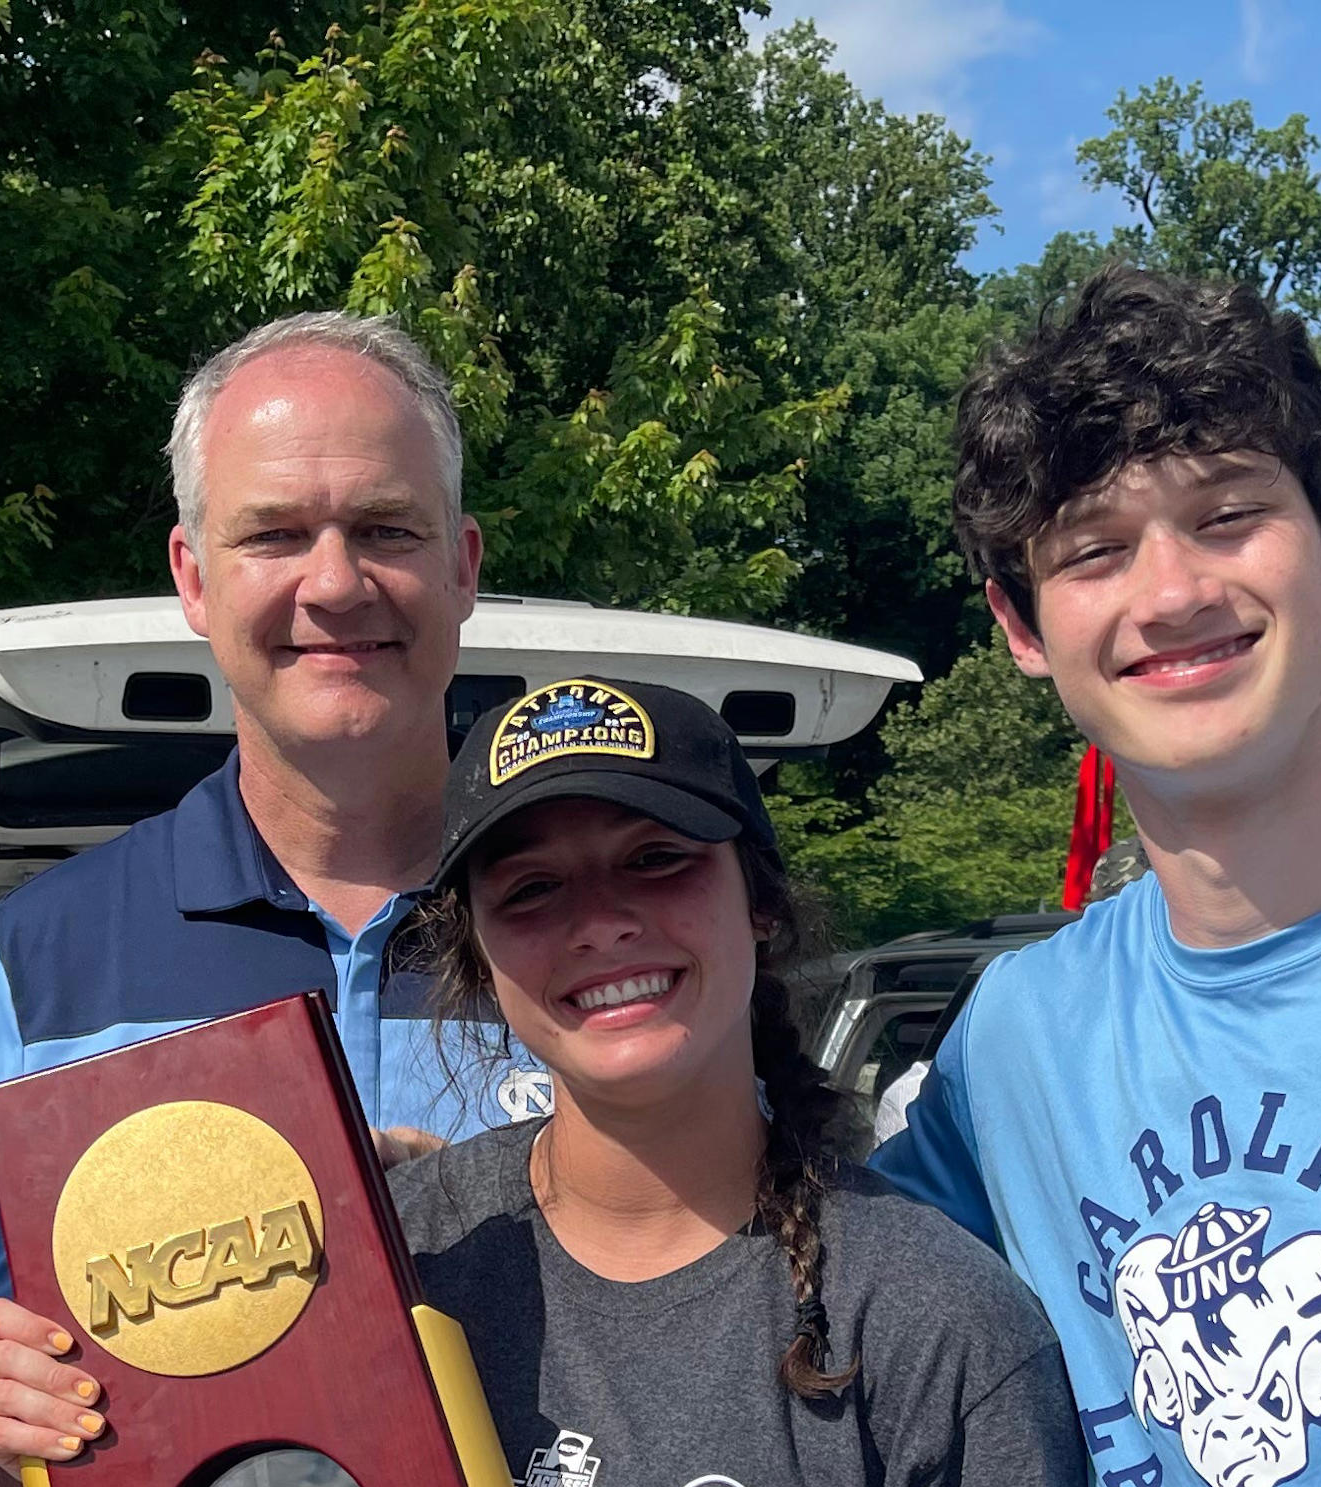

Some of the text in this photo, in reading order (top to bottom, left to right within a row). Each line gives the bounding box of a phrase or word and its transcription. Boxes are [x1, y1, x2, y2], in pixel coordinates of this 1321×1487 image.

[499, 685, 640, 748] NATIONAL
[499, 726, 644, 768] CHAMPIONS
[86, 1200, 320, 1334] NCAA
[1173, 1245, 1257, 1310] UNC
